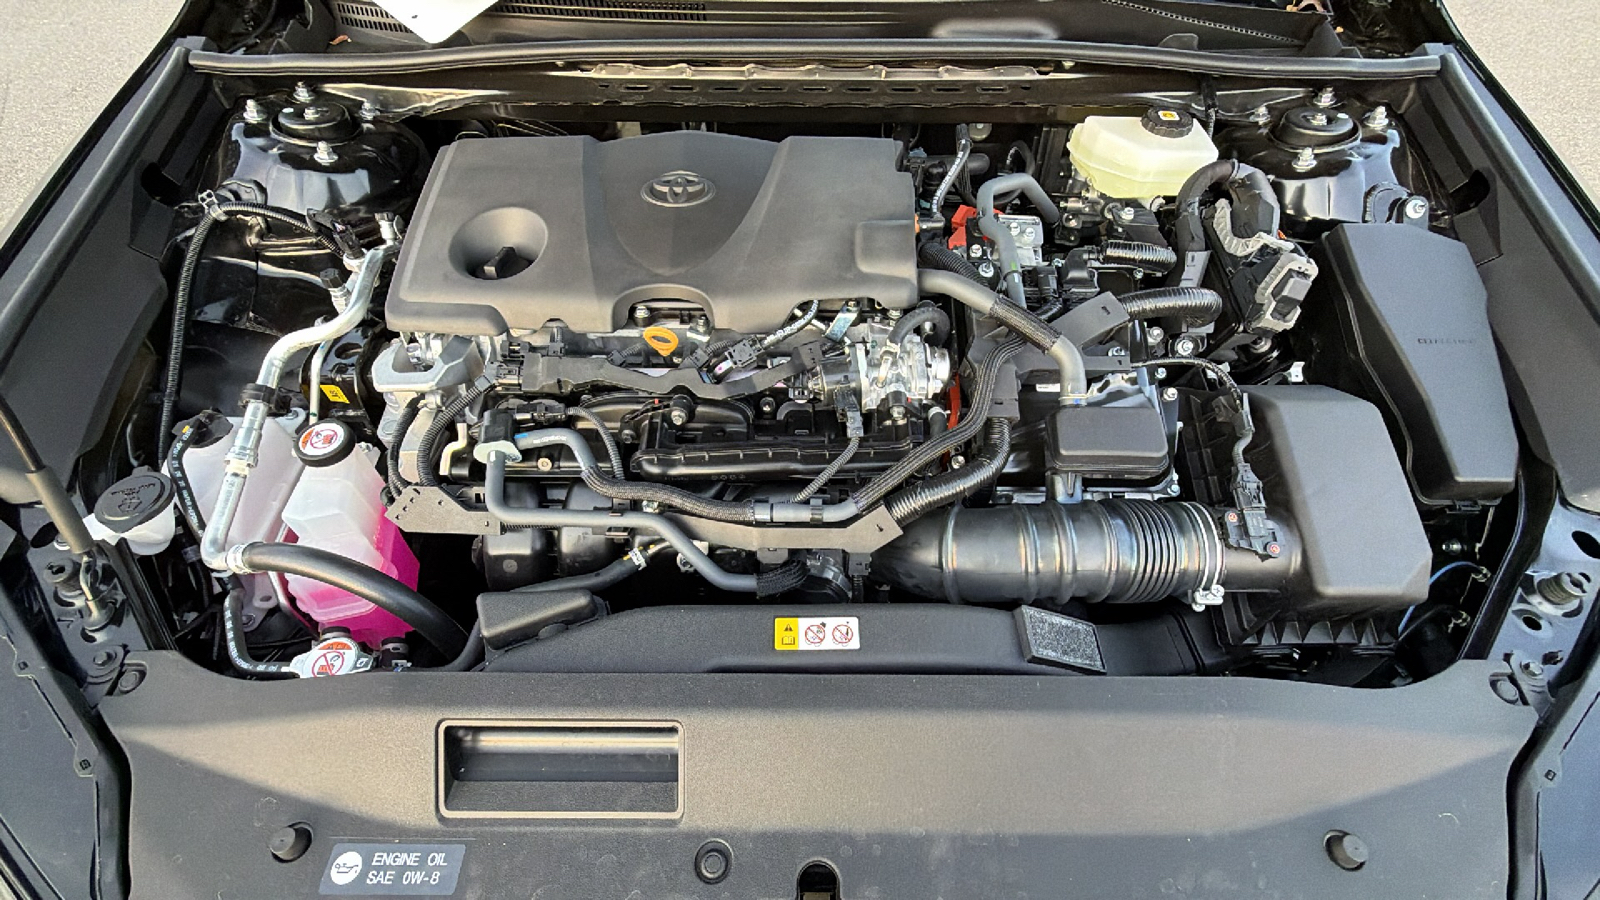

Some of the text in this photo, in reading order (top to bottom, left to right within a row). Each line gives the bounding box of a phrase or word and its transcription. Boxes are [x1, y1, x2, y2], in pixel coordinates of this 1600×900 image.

[371, 852, 448, 866] ENGINE OIL
[366, 870, 441, 885] SAE 0W-8
